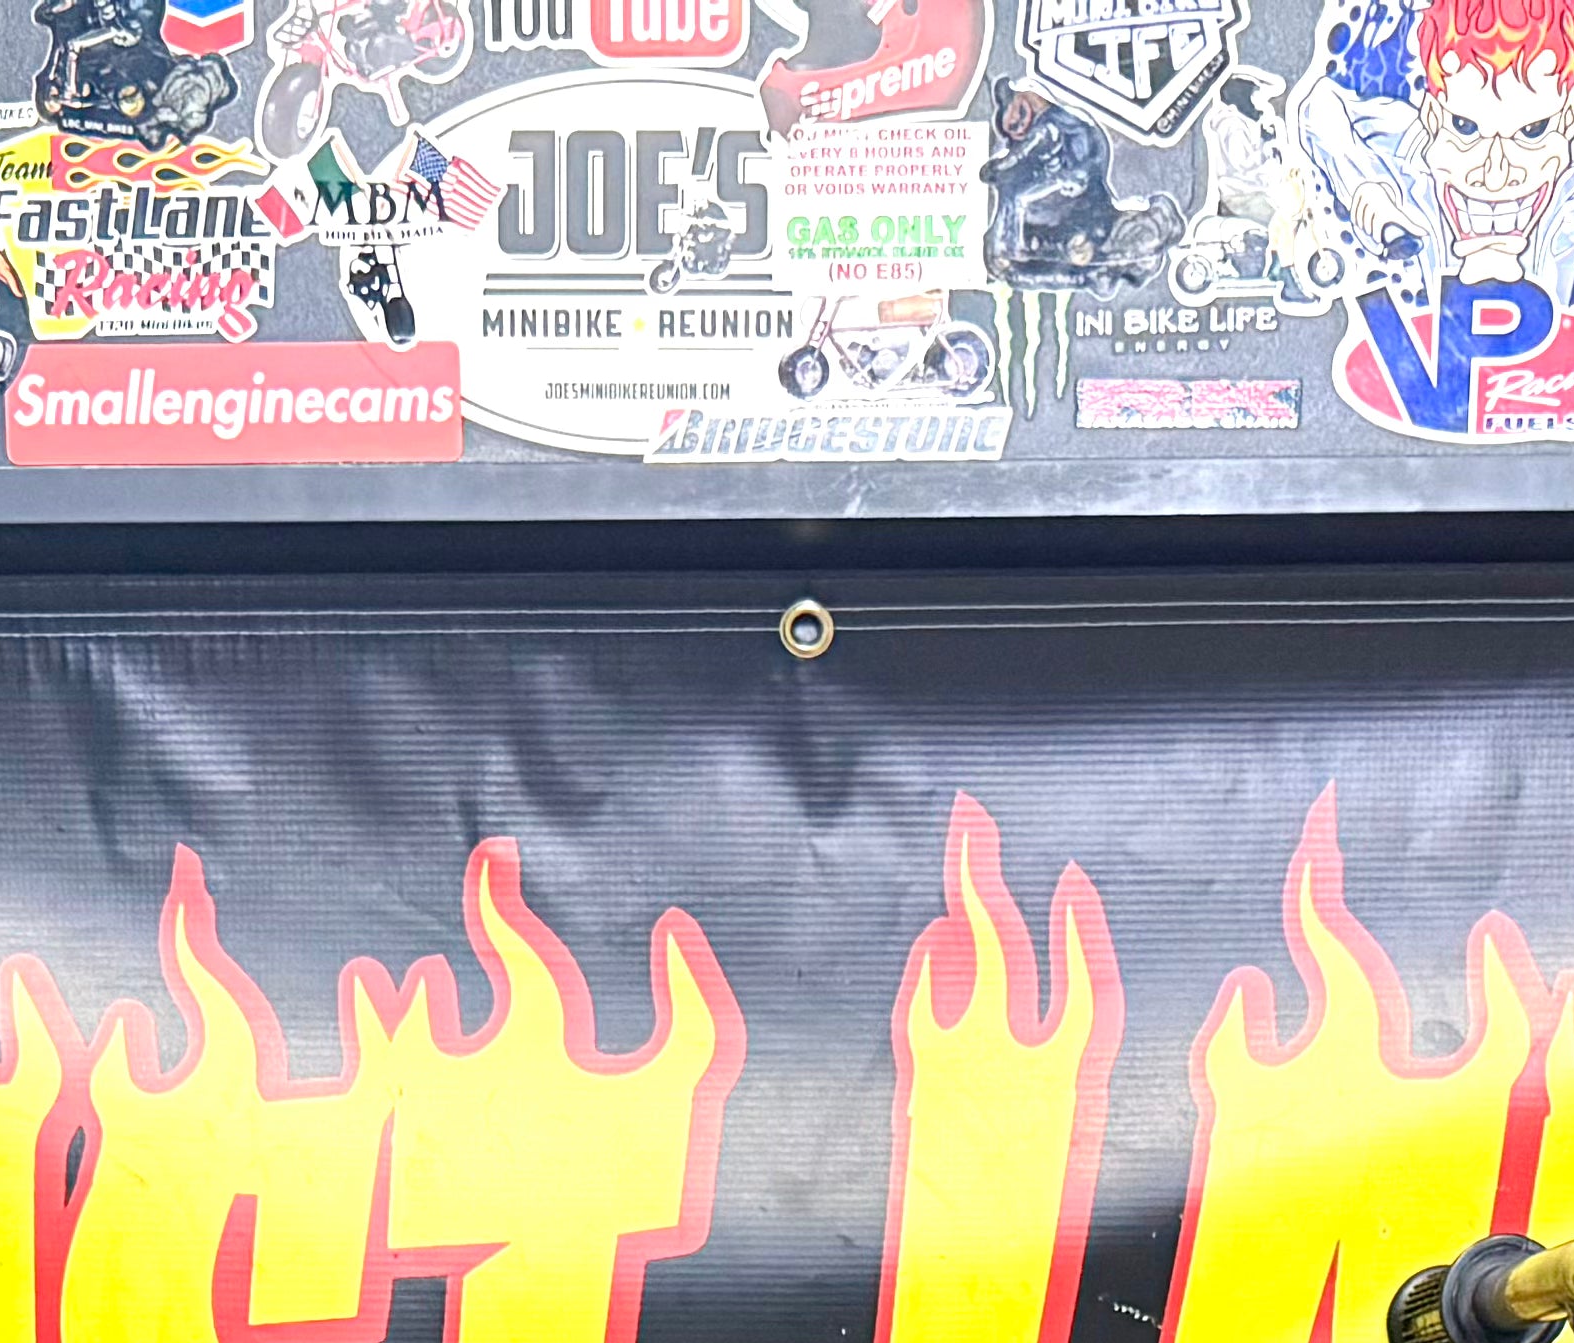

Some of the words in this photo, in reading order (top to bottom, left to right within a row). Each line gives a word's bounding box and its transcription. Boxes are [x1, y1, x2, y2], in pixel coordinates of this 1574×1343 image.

[799, 47, 956, 123] Supreme
[878, 129, 936, 140] CHECK
[944, 129, 971, 140] OIL
[865, 147, 923, 158] HOURS
[931, 146, 966, 158] AND
[790, 165, 867, 177] OPERATE
[875, 165, 963, 177] PROPERLY
[498, 127, 773, 259] JOE'S
[785, 184, 807, 195] OR
[814, 183, 865, 195] VOIDS
[872, 183, 968, 195] WARRANTY
[787, 216, 859, 246] GAS
[870, 215, 967, 245] ONLY
[829, 262, 867, 281] (NO
[877, 261, 923, 281] E85)
[50, 248, 259, 339] Racing
[482, 309, 623, 338] MINIBIKE
[658, 309, 794, 339] REUNION
[1124, 309, 1199, 335] BIKE
[1209, 306, 1278, 332] LIFE
[1356, 275, 1555, 434] VP
[14, 368, 454, 439] Smallenginecams
[545, 382, 731, 400] JOESMINIBIKEREUNION.COM
